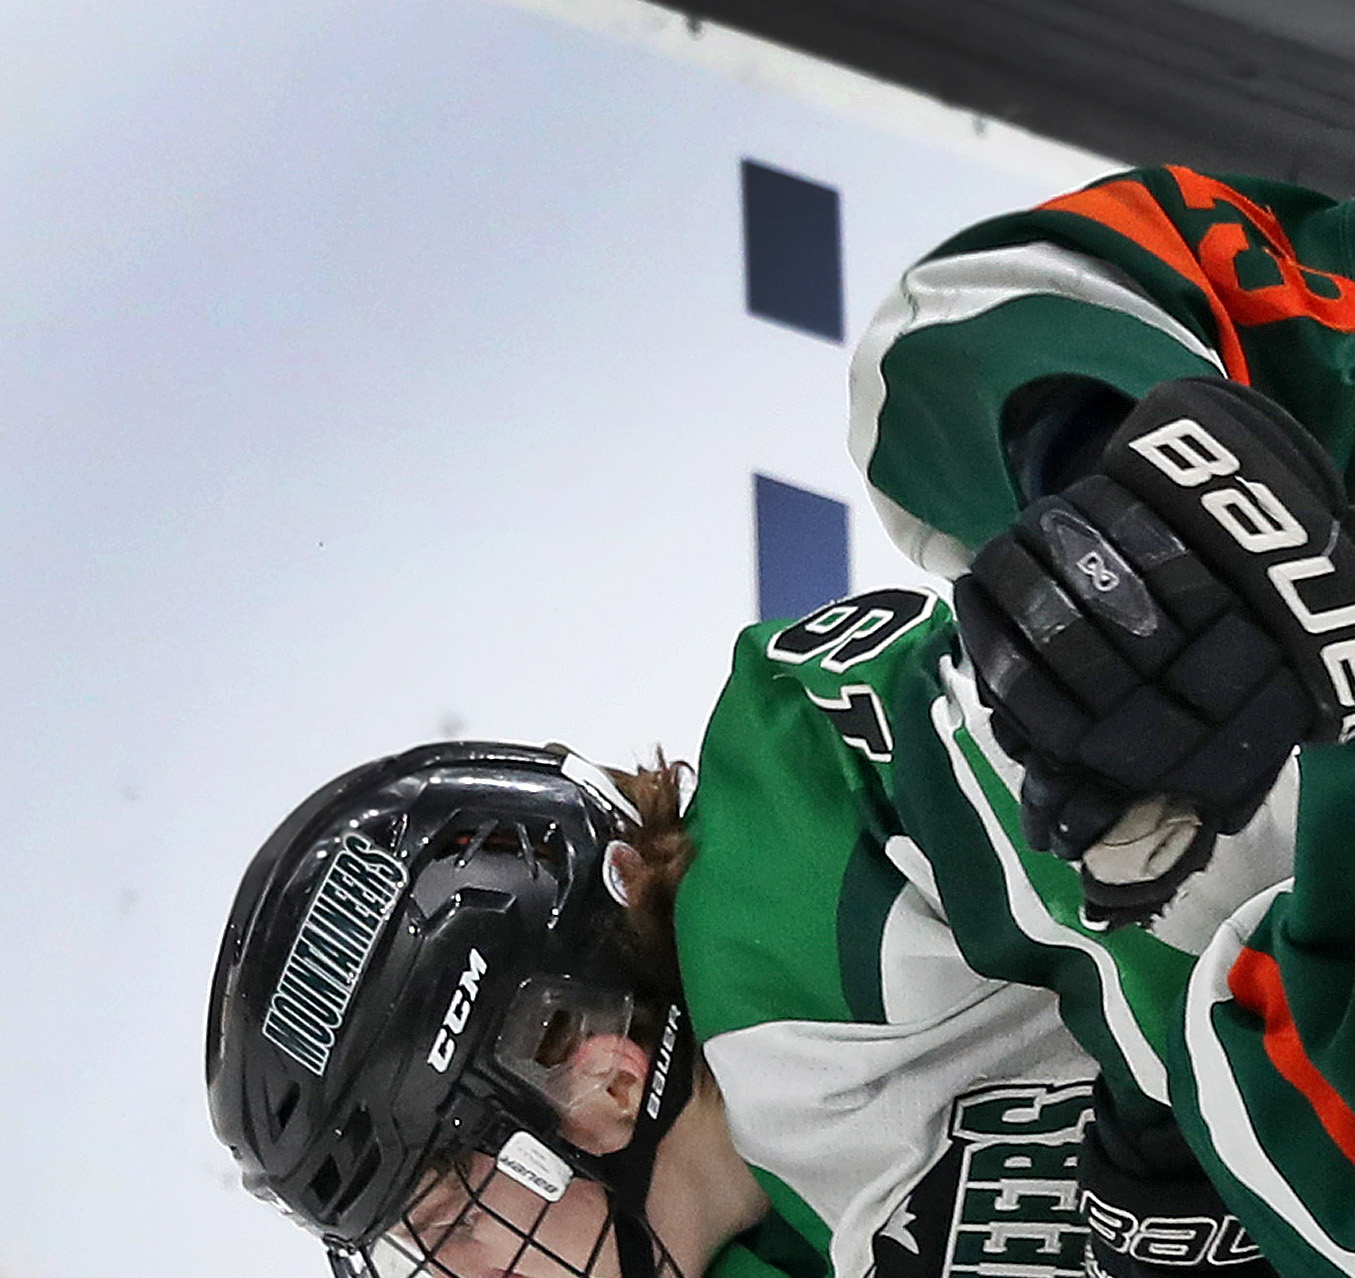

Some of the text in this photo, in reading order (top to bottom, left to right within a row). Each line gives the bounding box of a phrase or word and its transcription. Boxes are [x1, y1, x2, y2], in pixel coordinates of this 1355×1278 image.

[262, 833, 409, 1077] MOUNTAINEERS
[426, 947, 489, 1073] CCM
[646, 1004, 681, 1120] BAUER
